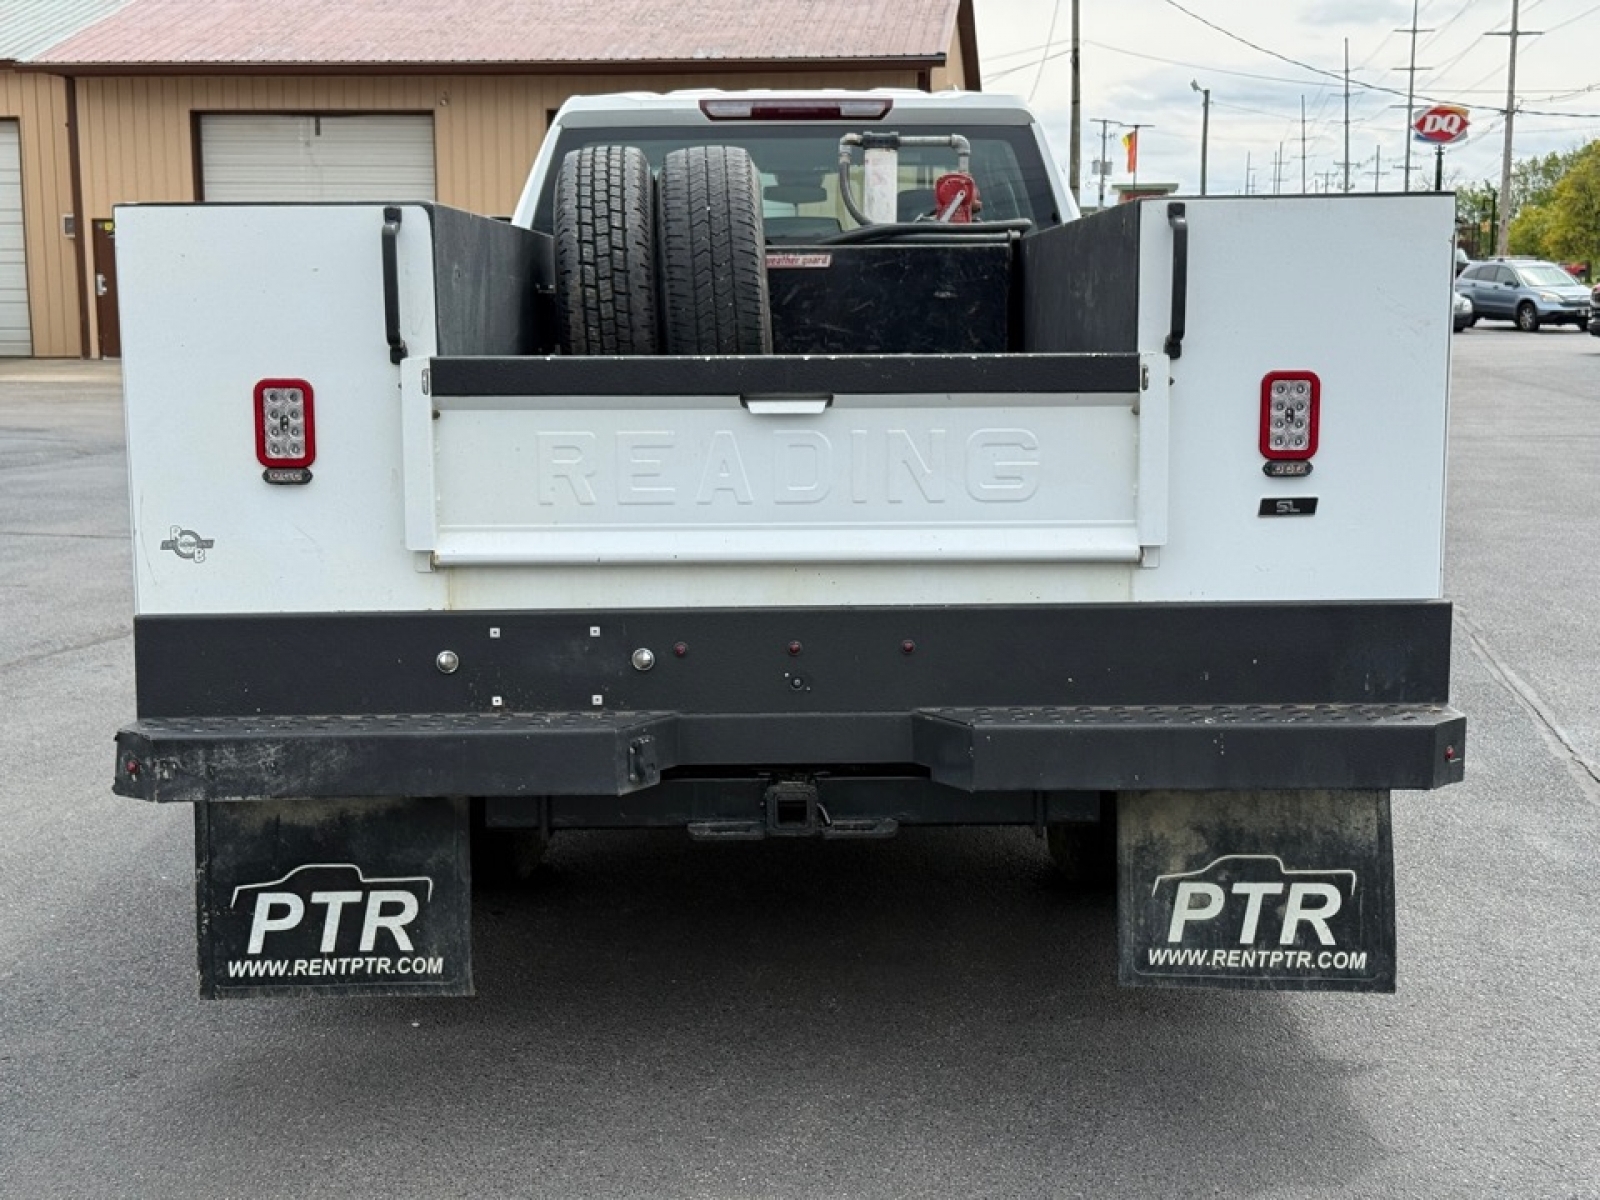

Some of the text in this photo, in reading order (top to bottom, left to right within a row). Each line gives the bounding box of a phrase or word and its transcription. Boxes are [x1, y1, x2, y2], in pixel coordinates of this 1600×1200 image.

[1423, 114, 1460, 134] DQ
[536, 428, 1040, 506] READING
[1276, 500, 1300, 512] SL
[247, 890, 419, 954] PTR
[1167, 882, 1342, 946] PTR
[227, 957, 444, 977] WWW.RENTPTR.COM
[1148, 948, 1367, 969] WWW.RENTPTR.COM
